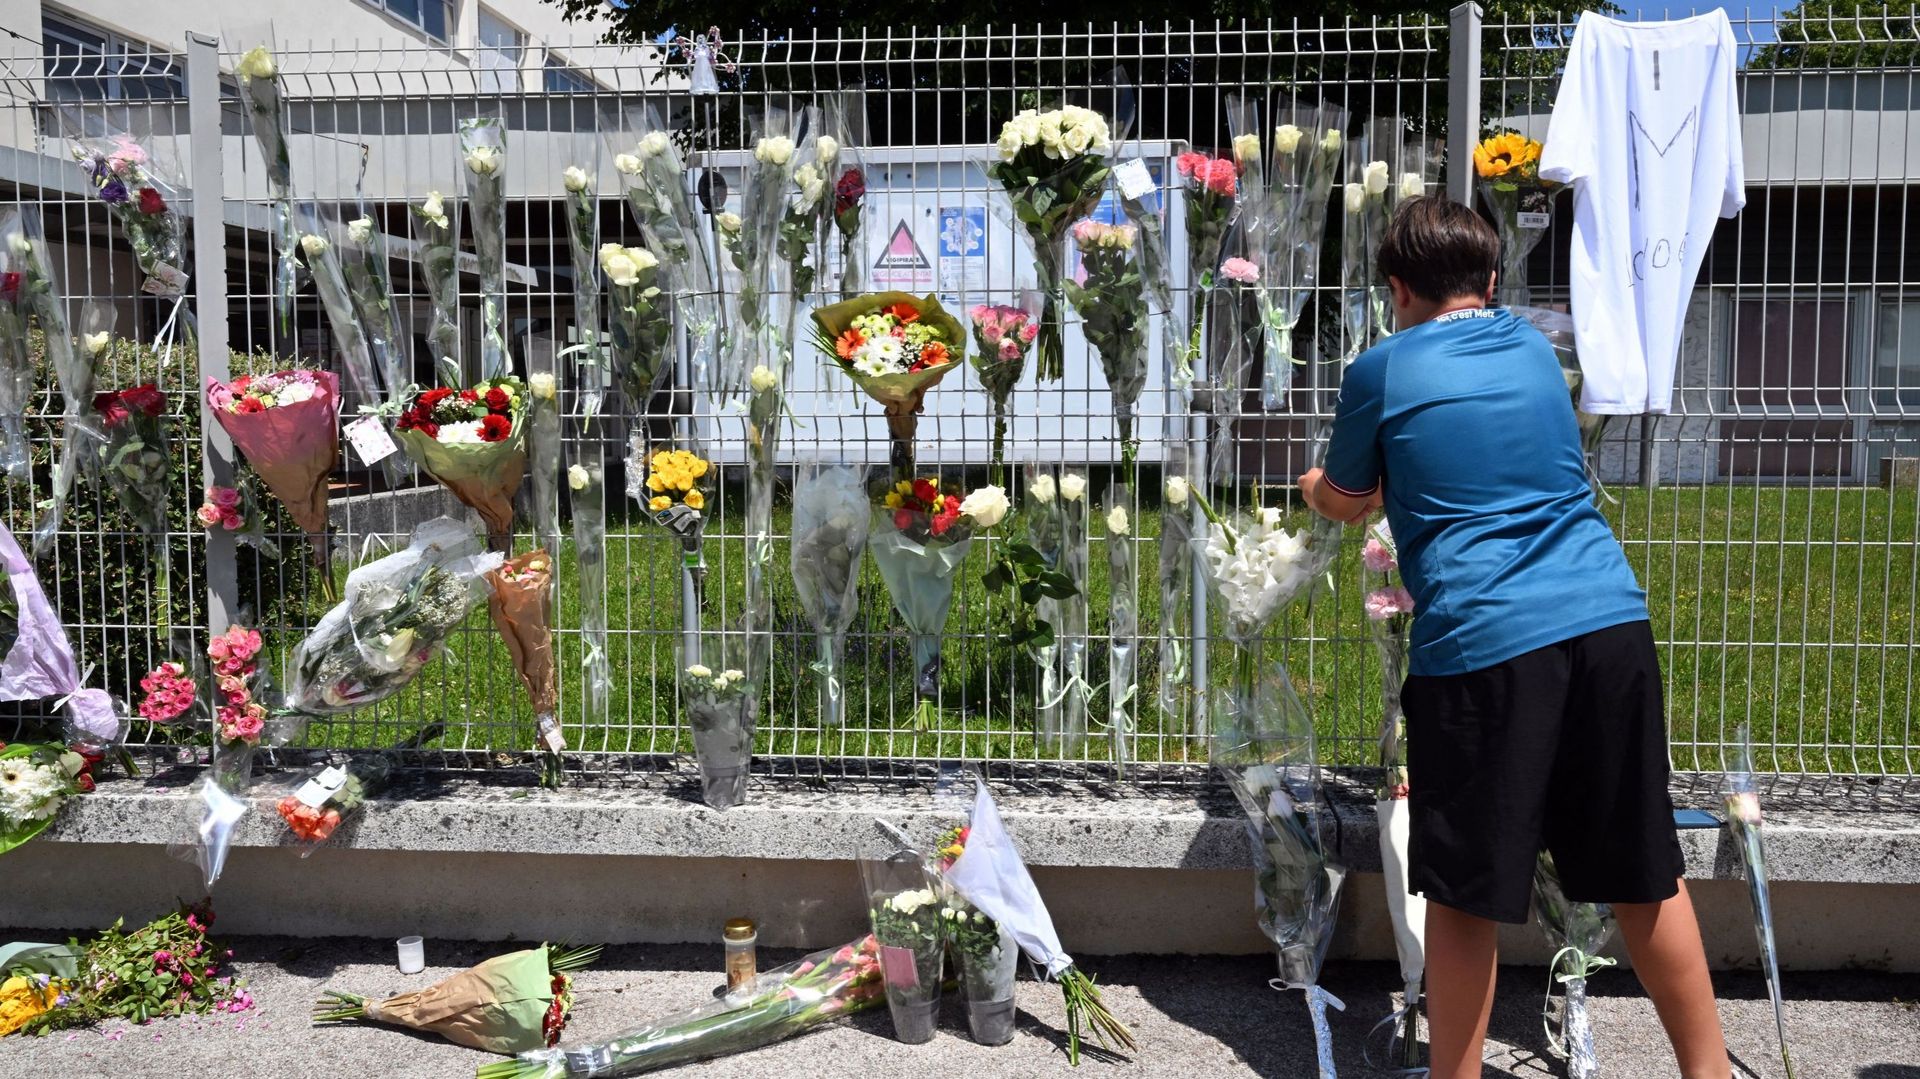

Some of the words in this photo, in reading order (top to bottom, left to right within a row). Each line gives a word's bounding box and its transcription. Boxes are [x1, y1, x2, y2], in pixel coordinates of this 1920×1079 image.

[872, 270, 902, 278] URGNCE
[1451, 310, 1473, 320] c'est
[1475, 309, 1495, 318] Metz
